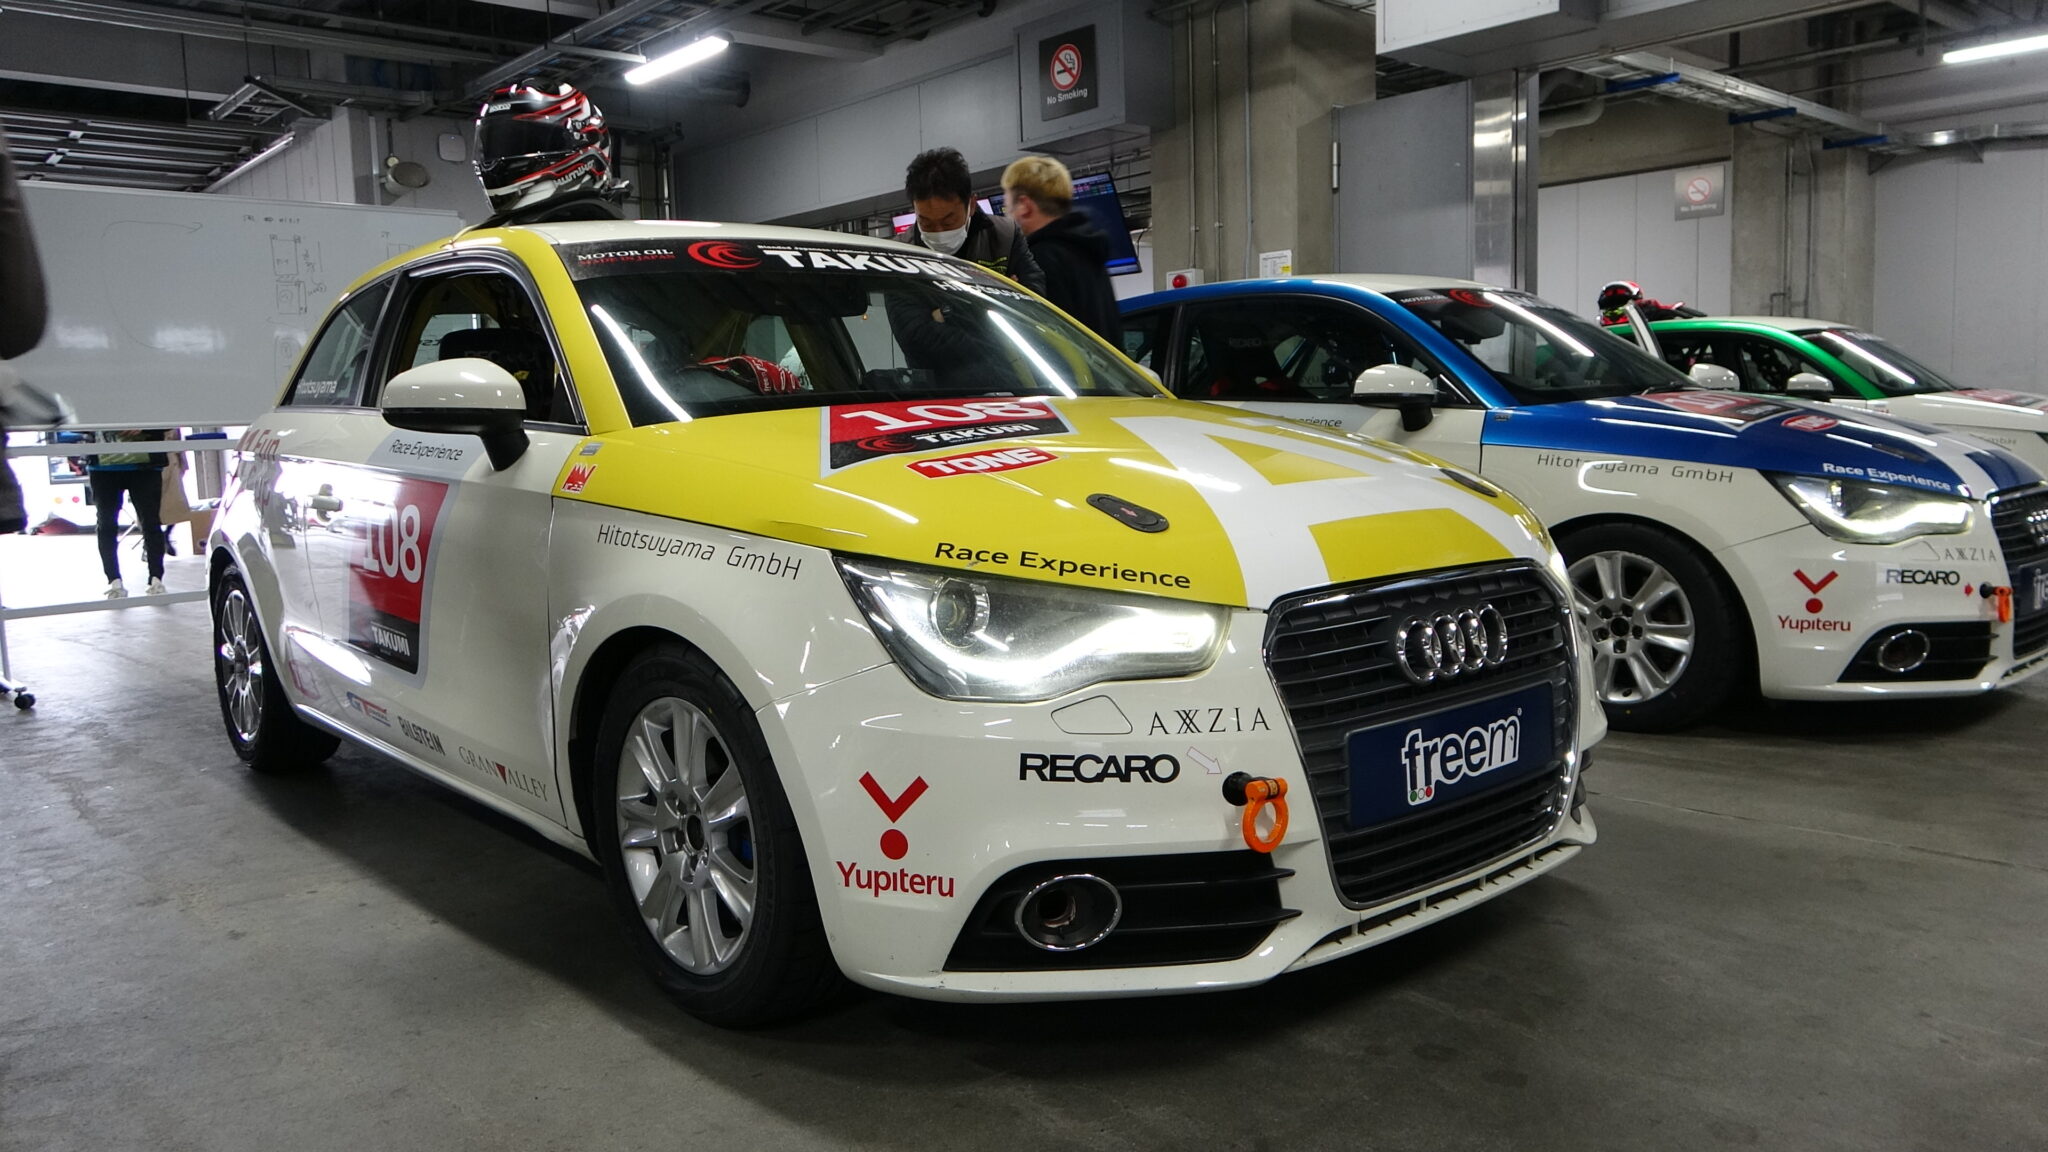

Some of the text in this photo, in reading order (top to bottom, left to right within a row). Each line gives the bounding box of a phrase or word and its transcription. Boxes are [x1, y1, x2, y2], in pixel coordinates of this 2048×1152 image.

[1047, 88, 1088, 105] No Smoking
[578, 250, 641, 261] MOTOR
[762, 250, 973, 279] TAKUMI
[840, 401, 1048, 431] 108
[917, 423, 1040, 443] TAKUMI
[389, 439, 464, 460] Race Experience
[918, 448, 1049, 474] TONE
[1537, 454, 1734, 483] Hitotuyama GmbH
[1822, 463, 1950, 491] Race Experience
[363, 503, 422, 583] 108
[597, 524, 802, 580] Hitotsuyama GmbH
[934, 542, 1191, 588] Race Experience
[1886, 569, 1961, 585] RECARO
[1777, 615, 1851, 633] Yupiteru
[371, 626, 410, 656] TAKUMI
[398, 716, 446, 756] BILSTEIN
[1148, 707, 1272, 736] AXXZIA
[1019, 753, 1180, 783] RECARO
[1402, 716, 1519, 805] freem
[836, 861, 954, 898] Yupiteru
